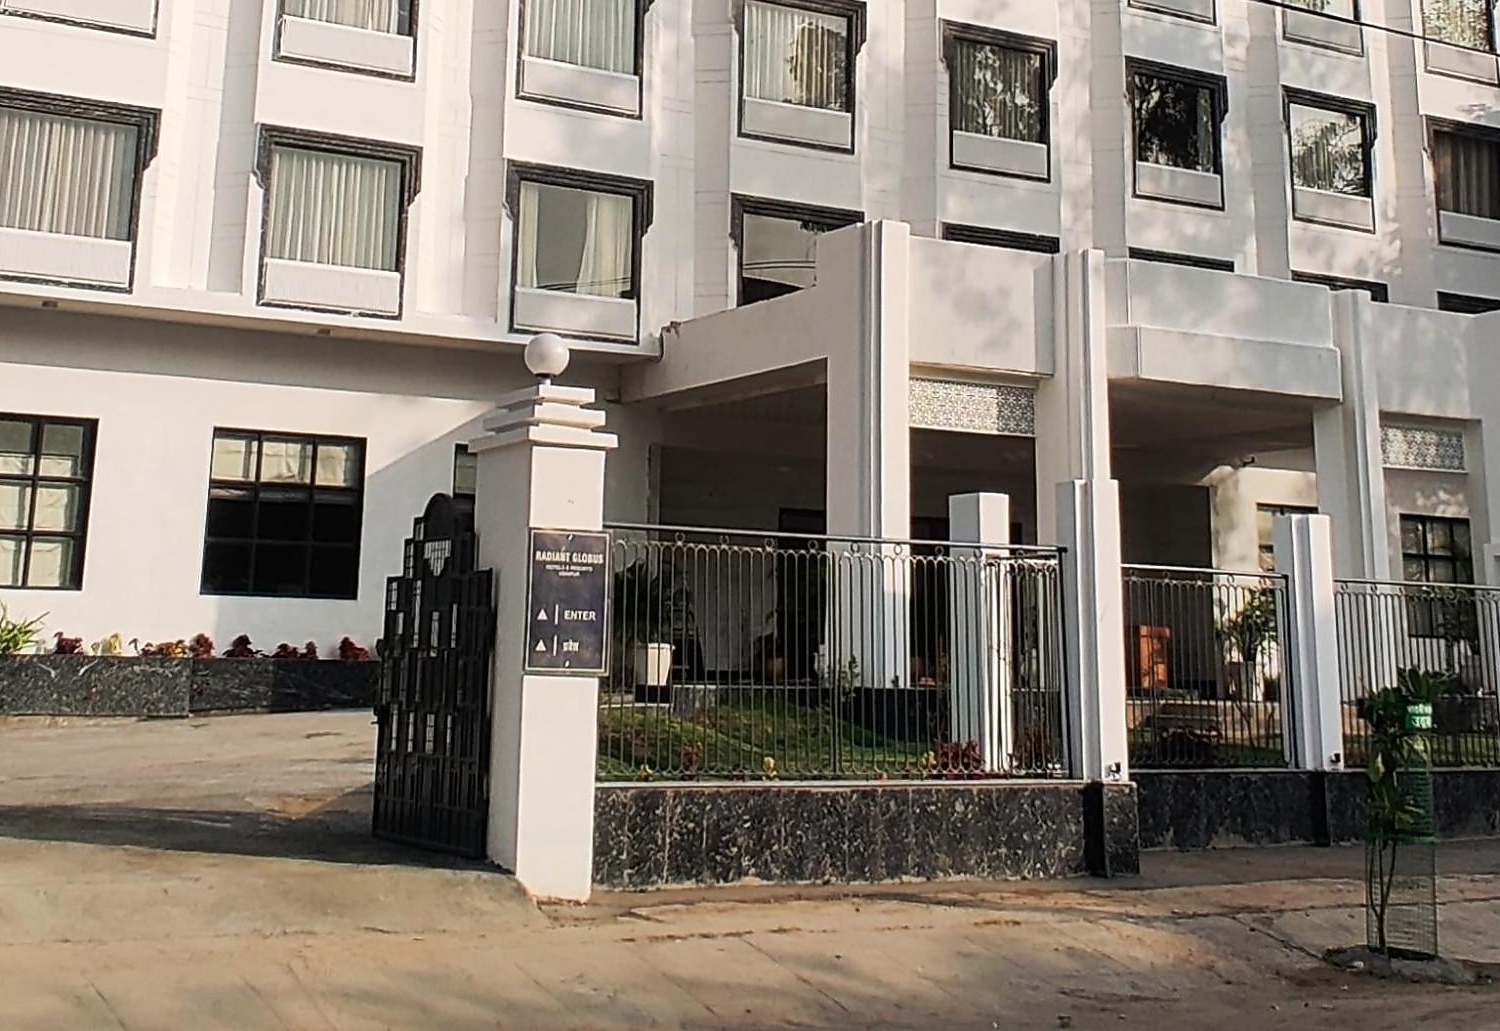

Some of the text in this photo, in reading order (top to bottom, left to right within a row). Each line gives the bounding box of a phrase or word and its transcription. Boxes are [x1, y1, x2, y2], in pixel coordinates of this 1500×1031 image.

[536, 551, 604, 563] RADIANT GLOBUS
[564, 610, 596, 621] ENTER
